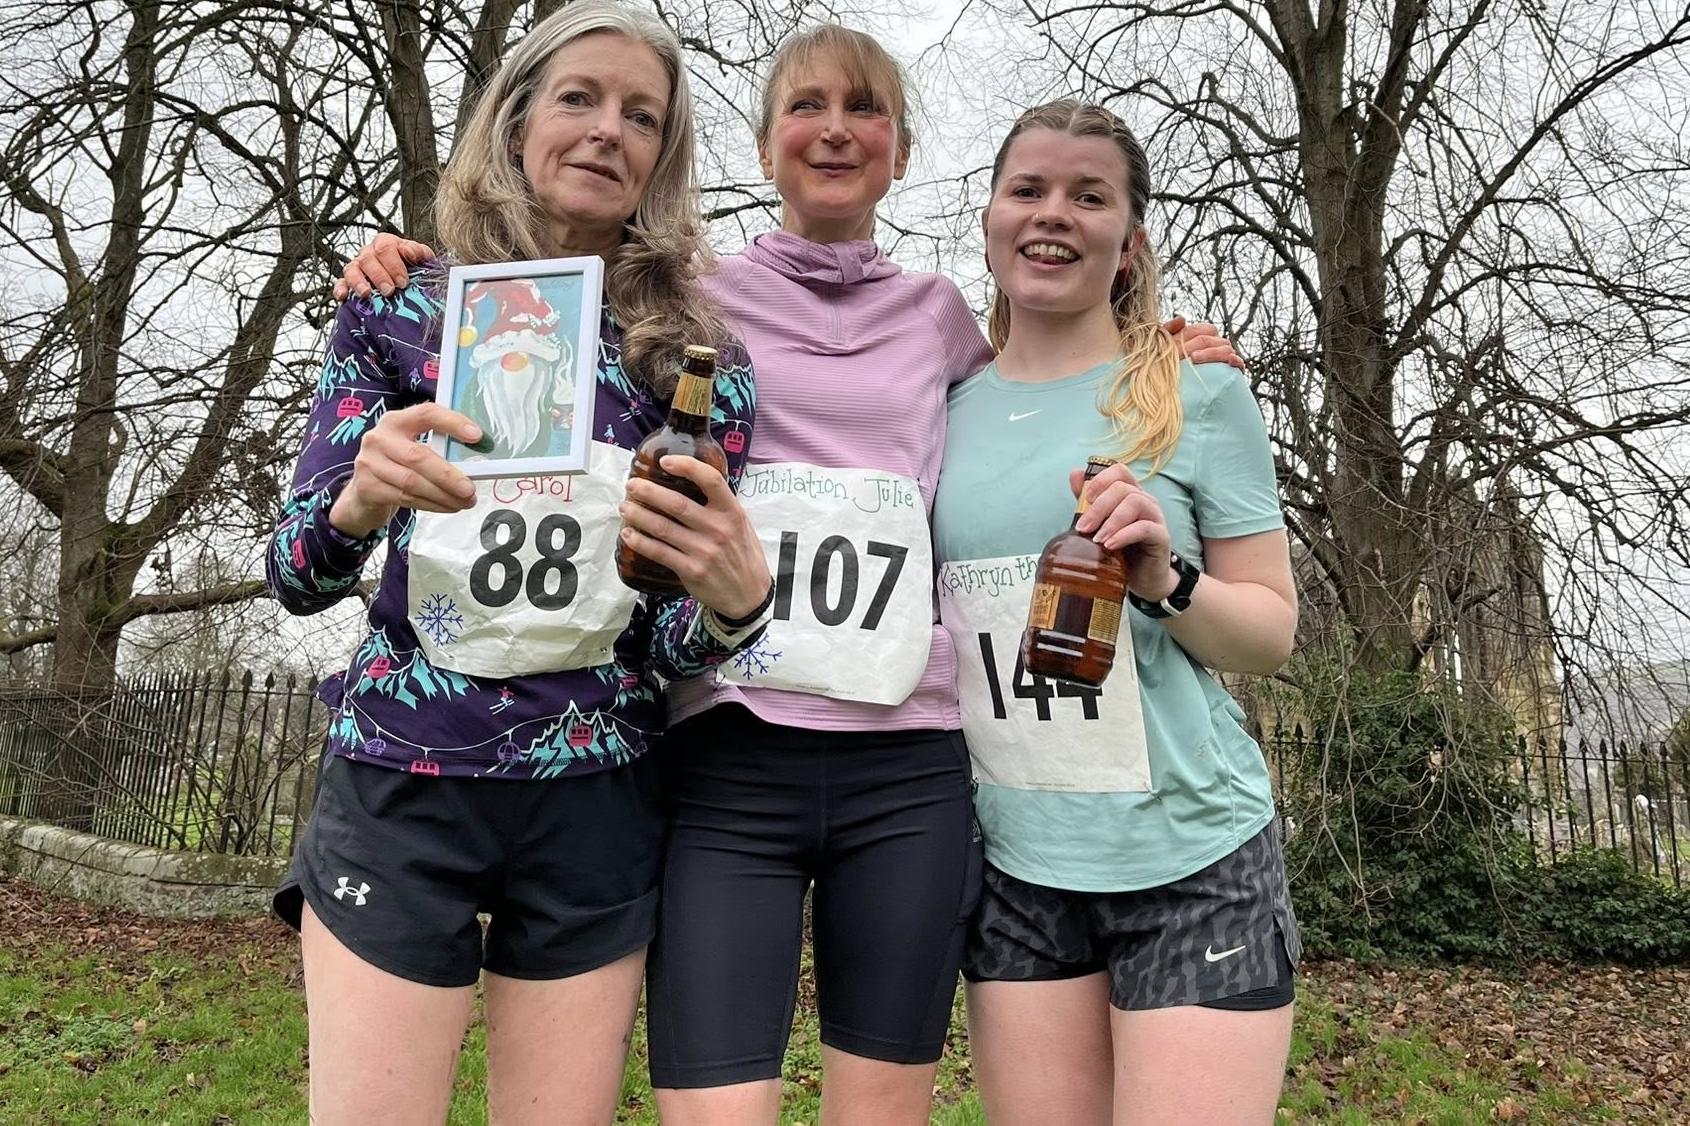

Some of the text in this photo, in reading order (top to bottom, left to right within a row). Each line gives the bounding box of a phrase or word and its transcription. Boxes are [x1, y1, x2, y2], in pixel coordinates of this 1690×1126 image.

[493, 475, 572, 503] Carol
[740, 468, 914, 513] Jubilation Julie
[469, 509, 581, 611] 88
[773, 531, 909, 631] 107
[940, 563, 1014, 598] Kathryn
